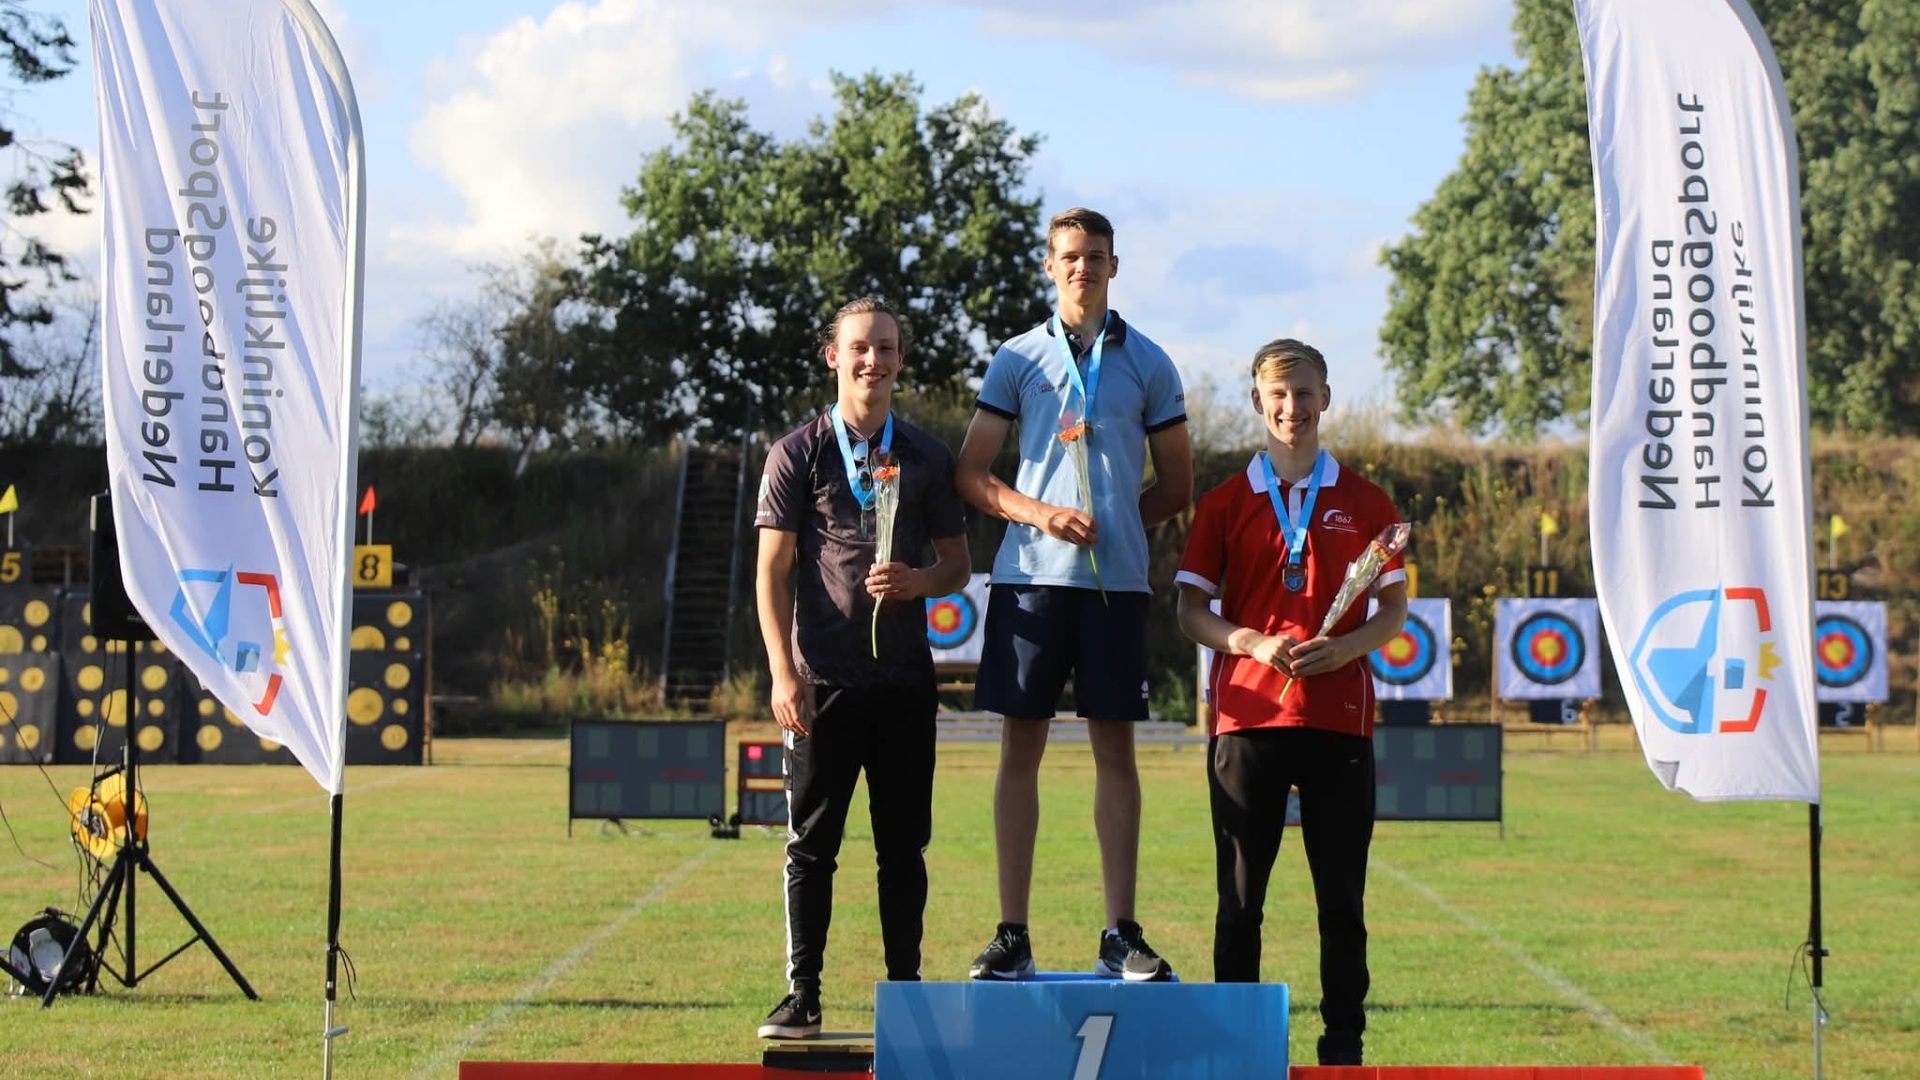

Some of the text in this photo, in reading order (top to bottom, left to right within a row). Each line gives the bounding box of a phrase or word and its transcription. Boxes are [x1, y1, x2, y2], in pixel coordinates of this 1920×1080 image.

[0, 552, 21, 583] 5
[359, 554, 380, 580] 8
[1534, 570, 1558, 596] 11
[1819, 572, 1848, 599] 13
[1072, 1015, 1114, 1080] 1
